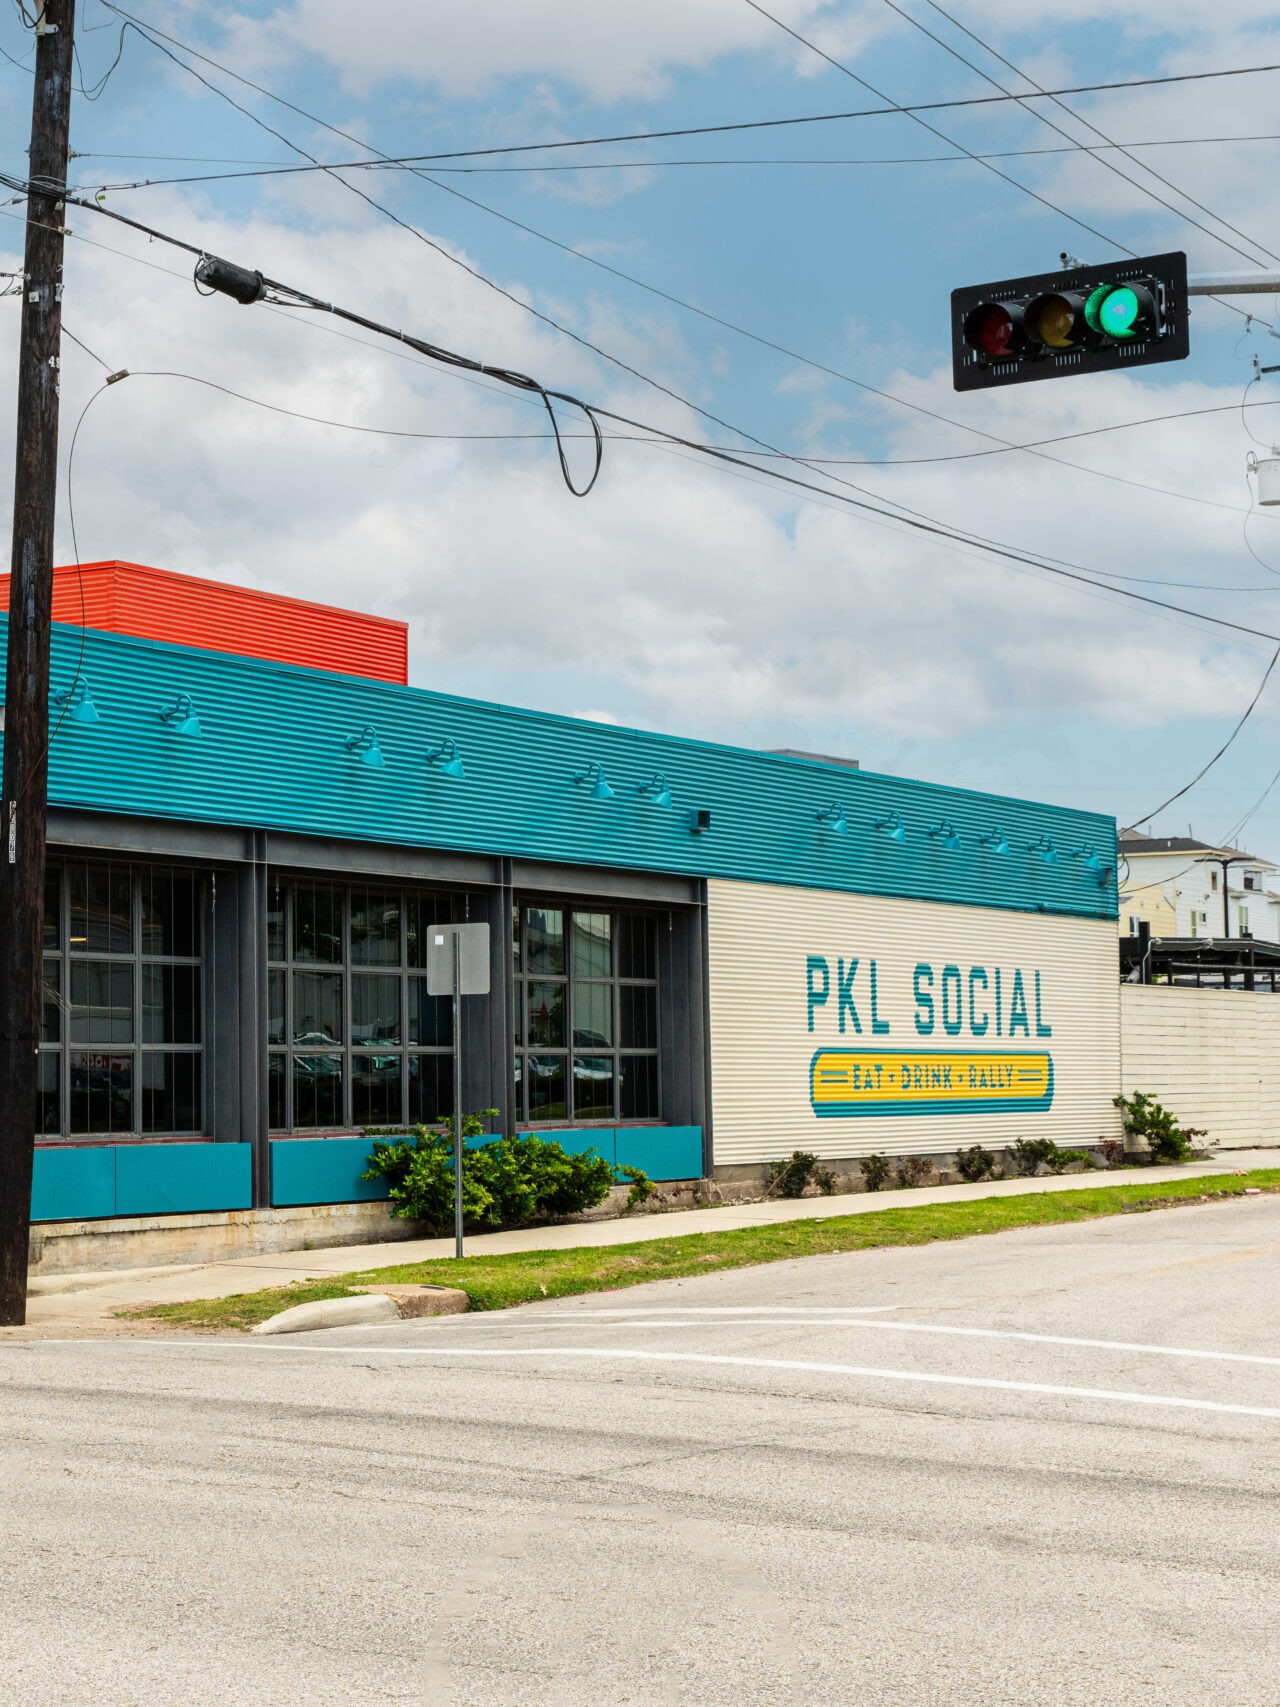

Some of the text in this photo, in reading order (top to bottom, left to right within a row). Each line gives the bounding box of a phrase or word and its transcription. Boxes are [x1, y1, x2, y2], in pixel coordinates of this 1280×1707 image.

[806, 955, 1052, 1037] PKL SOCIAL
[853, 1064, 1013, 1090] EAT DRINK RALLY
